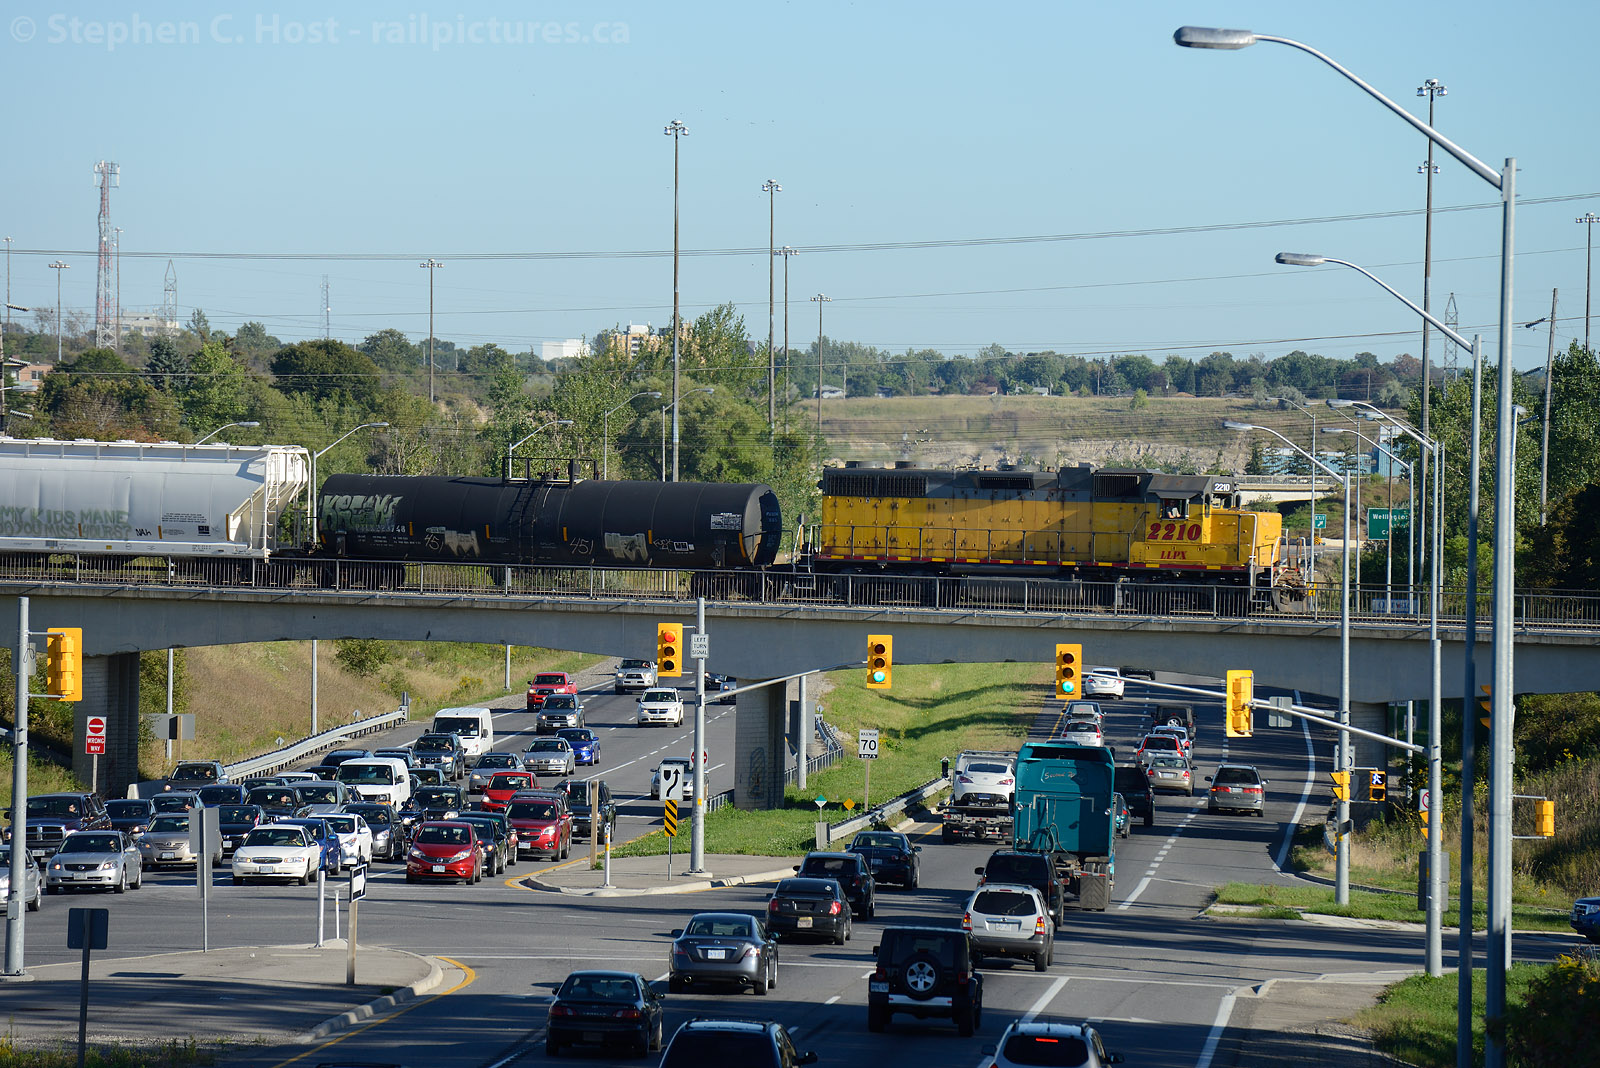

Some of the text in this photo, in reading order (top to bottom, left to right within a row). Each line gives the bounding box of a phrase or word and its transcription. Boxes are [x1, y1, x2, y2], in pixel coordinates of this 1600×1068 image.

[1214, 483, 1230, 492] 2210
[30, 508, 76, 525] KIDS
[1147, 522, 1201, 541] 2210
[570, 536, 594, 555] 451
[1160, 550, 1187, 560] LLPX
[860, 739, 877, 751] 70
